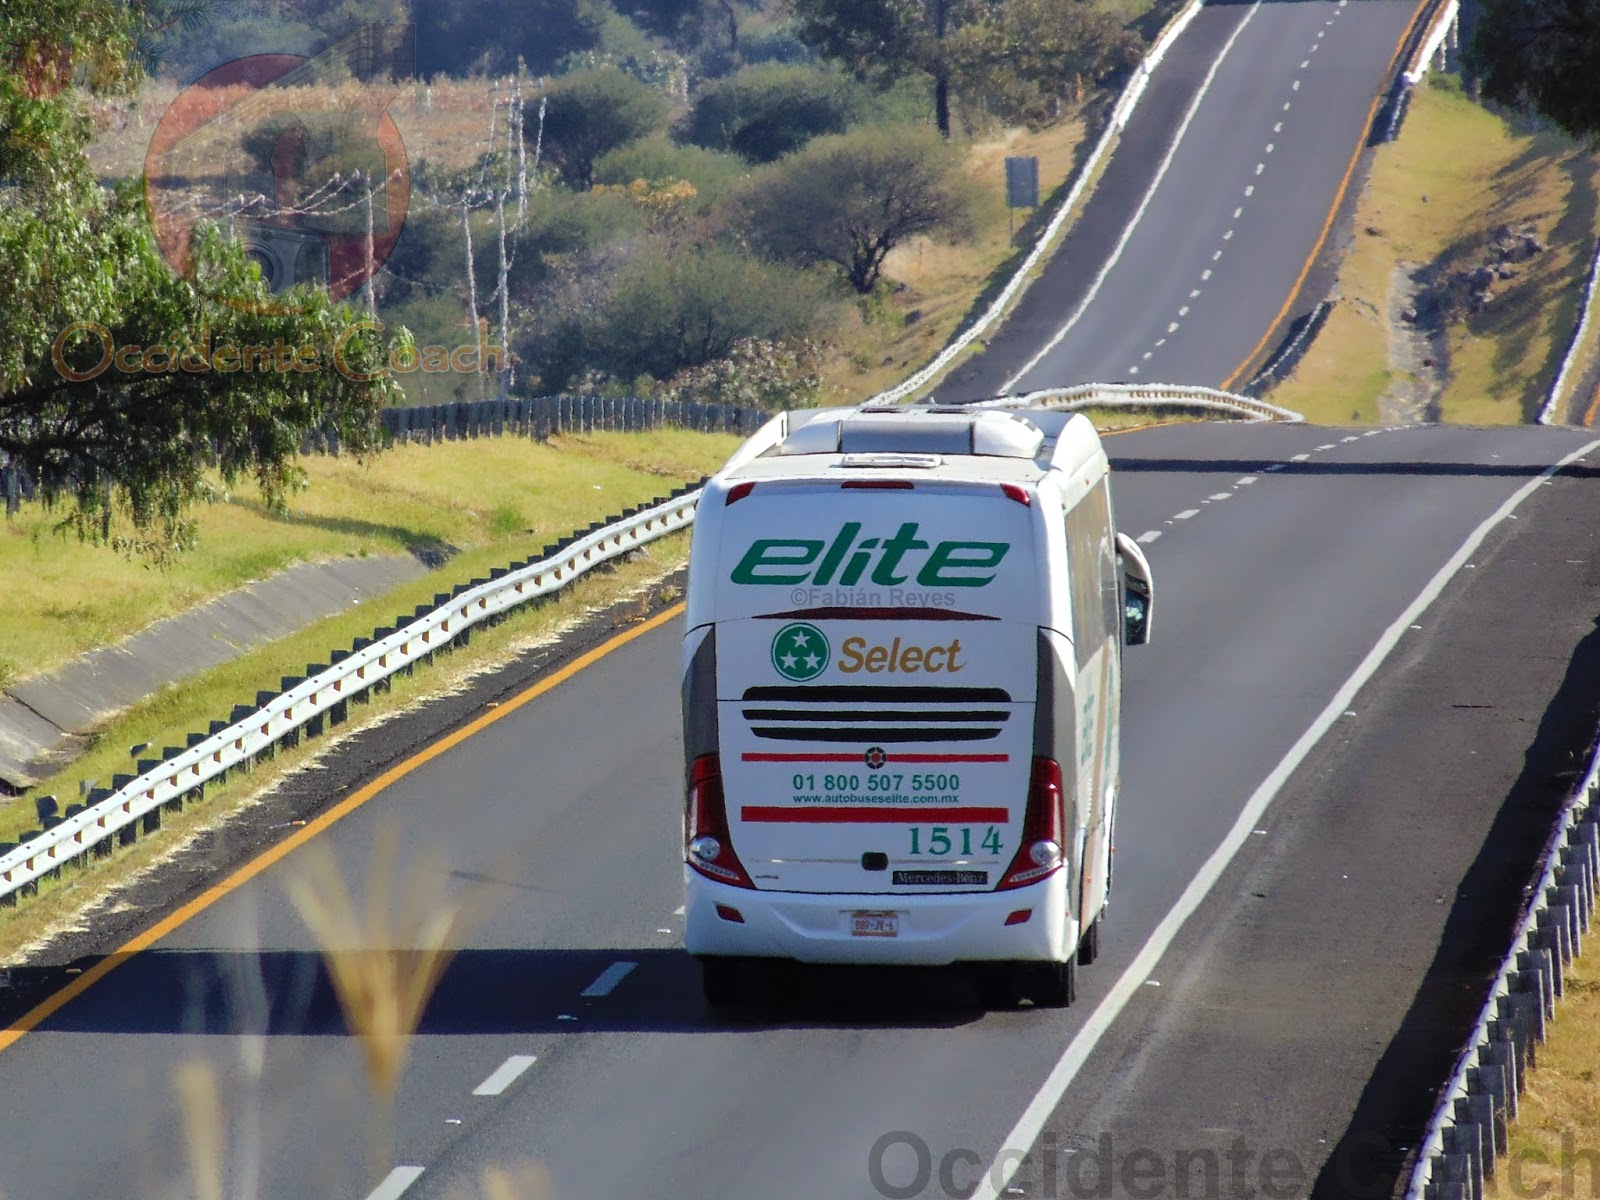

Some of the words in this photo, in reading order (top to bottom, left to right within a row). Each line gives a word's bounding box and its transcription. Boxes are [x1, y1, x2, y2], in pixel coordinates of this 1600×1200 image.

[730, 522, 1011, 587] elite
[838, 636, 967, 674] Select
[792, 773, 815, 791] 01
[824, 774, 860, 791] 800
[867, 774, 904, 791] 507
[911, 774, 960, 791] 5500
[792, 793, 960, 804] www.autobuseselite.com.mx
[908, 825, 1004, 855] 1514
[898, 871, 984, 884] Mercedes-Benz
